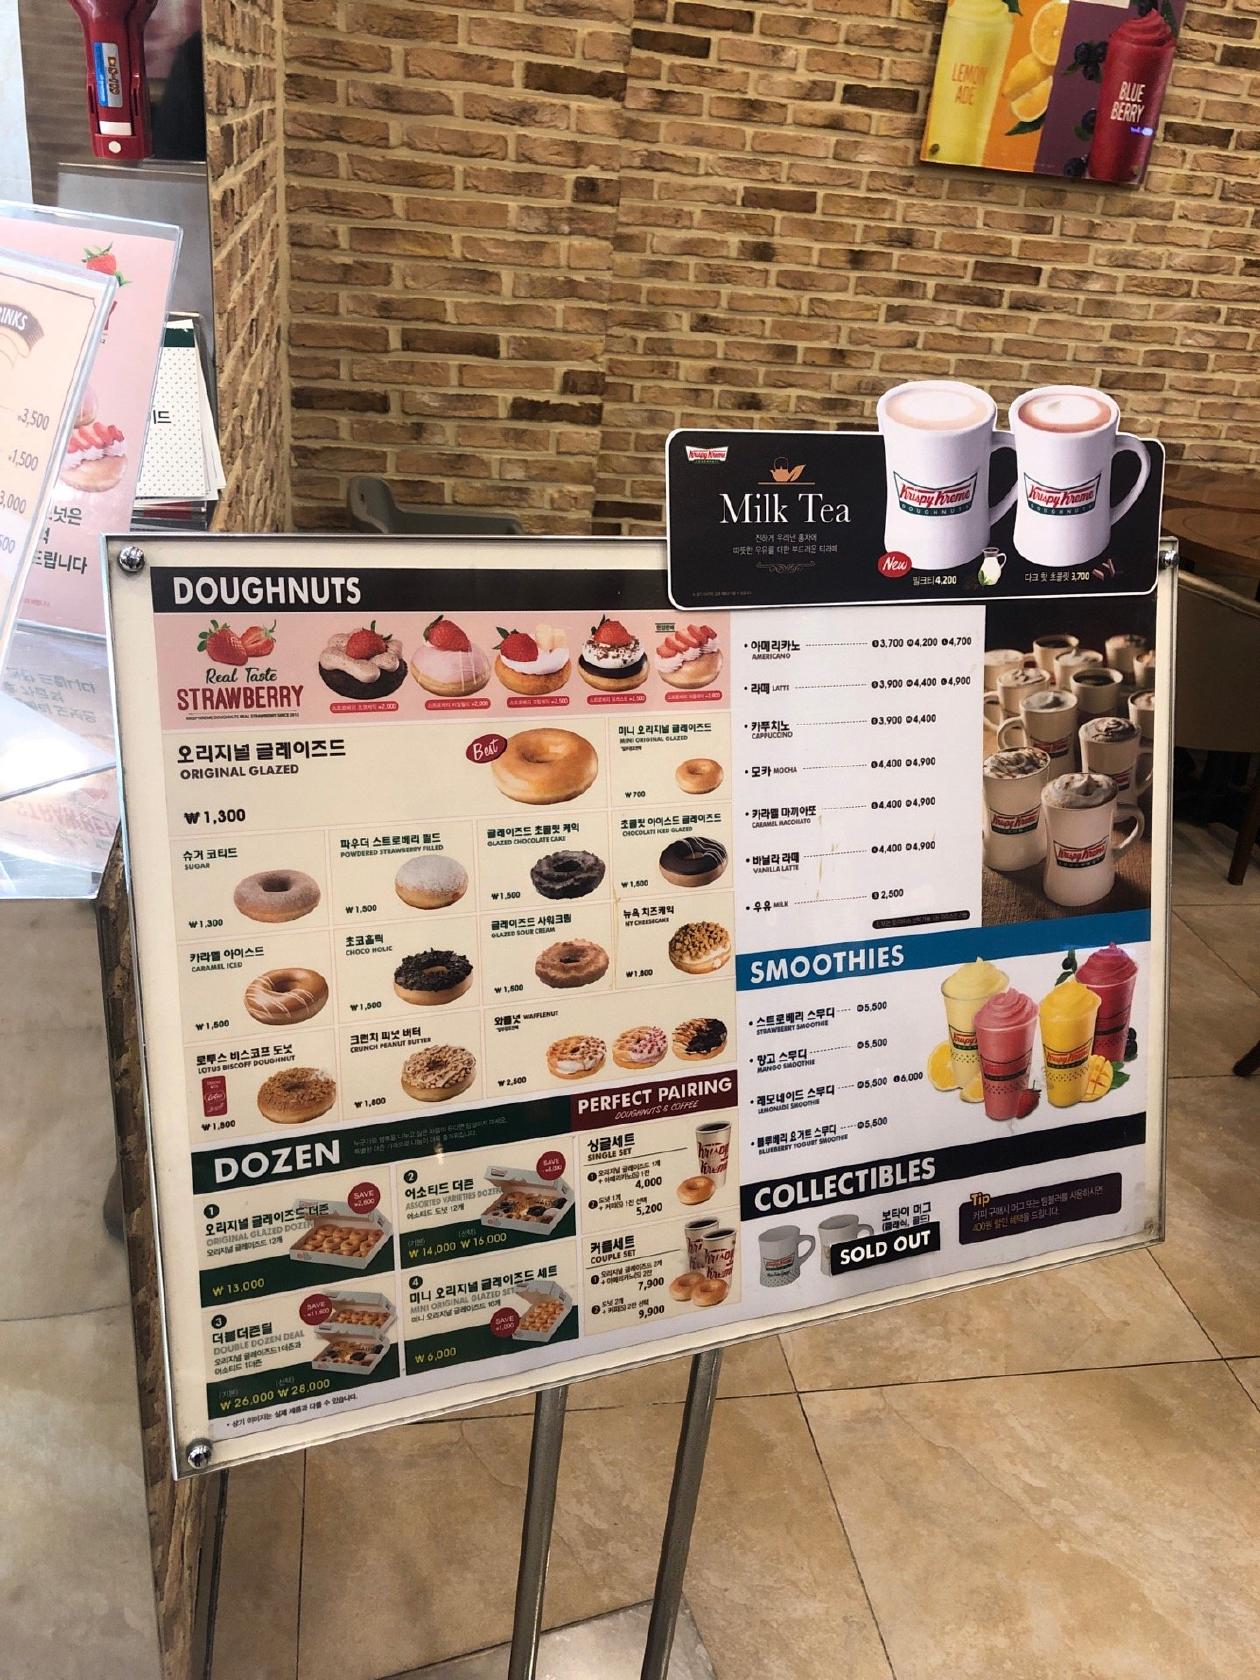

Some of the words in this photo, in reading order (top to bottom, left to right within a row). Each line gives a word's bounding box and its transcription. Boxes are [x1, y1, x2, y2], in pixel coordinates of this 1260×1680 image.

[951, 63, 988, 84] LEMON
[956, 86, 977, 105] ADE
[1119, 81, 1145, 102] BLUE
[1110, 101, 1145, 123] BERRY
[899, 483, 934, 508] Krispy
[934, 483, 971, 507] Kreme
[1028, 484, 1061, 507] Krispy
[1060, 484, 1094, 507] Kreme
[49, 505, 82, 525] 넛은
[720, 493, 789, 523] Milk
[798, 493, 851, 523] Tea
[882, 556, 908, 571] New
[1071, 572, 1090, 581] 3,700
[173, 577, 361, 605] DOUGHNUTS
[751, 640, 800, 652] 아메리카노
[206, 668, 238, 684] Real
[245, 667, 278, 682] Taste
[751, 683, 770, 694] 라떼
[772, 684, 789, 692] LATTE
[177, 685, 304, 711] STRAWBERRY
[619, 726, 634, 735] 미니
[637, 725, 669, 734] 오리지널
[672, 723, 712, 733] 글레이즈드
[751, 720, 790, 732] 카푸치노
[177, 743, 250, 763] 오리지널
[256, 739, 346, 760] 글레이즈드
[473, 738, 499, 761] Best
[180, 766, 246, 780] ORIGINAL
[249, 764, 299, 775] GLAZED
[751, 766, 771, 778] 모카
[752, 808, 779, 820] 카라멜
[781, 805, 816, 817] 마끼아또
[620, 819, 645, 830] 초콜릿
[647, 815, 680, 827] 아이스드
[682, 813, 722, 825] 글레이즈드
[487, 827, 532, 839] 글레이즈드
[534, 825, 560, 835] 초콜릿
[340, 838, 369, 849] 파우더
[373, 834, 419, 846] 스트로베리
[183, 850, 203, 861] 슈거
[207, 847, 238, 859] 코티드
[340, 850, 378, 858] POWDERED
[380, 846, 421, 855] STRAWBERRY
[753, 854, 780, 865] 바닐라
[782, 852, 800, 863] 라떼
[753, 901, 771, 912] 우유
[881, 889, 904, 899] 2,500
[491, 917, 536, 931] 글레이즈드
[537, 913, 572, 926] 사워크림
[623, 908, 640, 919] 뉴욕
[346, 934, 384, 947] 초코홀릭
[190, 950, 220, 963] 카라멜
[224, 946, 264, 959] 아이스드
[346, 948, 370, 956] CHOCO
[192, 964, 225, 972] CARAMEL
[750, 944, 905, 984] SMOOTHIES
[494, 1014, 521, 1026] 와플넛
[756, 1011, 804, 1028] 스트로베리
[807, 1007, 835, 1021] 스무디
[350, 1032, 379, 1045] 크런치
[382, 1030, 400, 1041] 피넛
[402, 1027, 421, 1037] 버터
[196, 1054, 227, 1066] 로투스
[230, 1046, 270, 1061] 비스코프
[273, 1044, 293, 1055] 도넛
[253, 1055, 296, 1066] DOUGHNUT
[757, 1054, 776, 1066] 망고
[779, 1048, 807, 1062] 스무디
[578, 1089, 652, 1115] PERFECT
[658, 1077, 732, 1102] PAIRING
[757, 1090, 804, 1107] 레모네이드
[807, 1085, 835, 1099] 스무디
[615, 1106, 661, 1120] DOUGHNUTS
[671, 1100, 699, 1111] COFFEE
[758, 1103, 789, 1115] LEMONADE
[587, 1133, 635, 1153] 싱글세트
[757, 1132, 788, 1148] 블루베리
[790, 1130, 812, 1142] 요거트
[814, 1124, 837, 1138] 스무디
[587, 1151, 617, 1162] SINGLE
[619, 1148, 632, 1157] SET
[758, 1145, 792, 1155] BLUEBERRY
[214, 1139, 341, 1184] DOZEN
[404, 1182, 449, 1200] 어소티드
[452, 1178, 474, 1191] 더즌
[635, 1177, 662, 1189] 4,000
[754, 1157, 936, 1212] COLLECTIBLES
[970, 1192, 990, 1207] Tip
[636, 1203, 662, 1216] 5,200
[882, 1207, 909, 1222] 보타이
[913, 1202, 931, 1215] 머그
[973, 1211, 987, 1219] 커피
[1011, 1203, 1024, 1213] 머그
[205, 1218, 249, 1236] 오리지널
[252, 1207, 305, 1228] 글레이즈드
[308, 1203, 330, 1216] 더즌
[206, 1233, 249, 1247] ORIGINAL
[590, 1235, 635, 1254] 커플세트
[840, 1241, 887, 1265] SOLD
[893, 1230, 931, 1254] OUT
[591, 1252, 621, 1264] COUPLE
[623, 1249, 636, 1258] SET
[410, 1291, 431, 1304] 미니
[435, 1281, 478, 1299] 오리지널
[482, 1269, 535, 1291] 글레이즈드
[538, 1265, 557, 1278] 세트
[638, 1277, 664, 1291] 7,900
[638, 1305, 665, 1319] 9,900
[212, 1322, 273, 1344] 더블더즌딜
[232, 1417, 245, 1427] 상기
[247, 1413, 272, 1424] 이미지는
